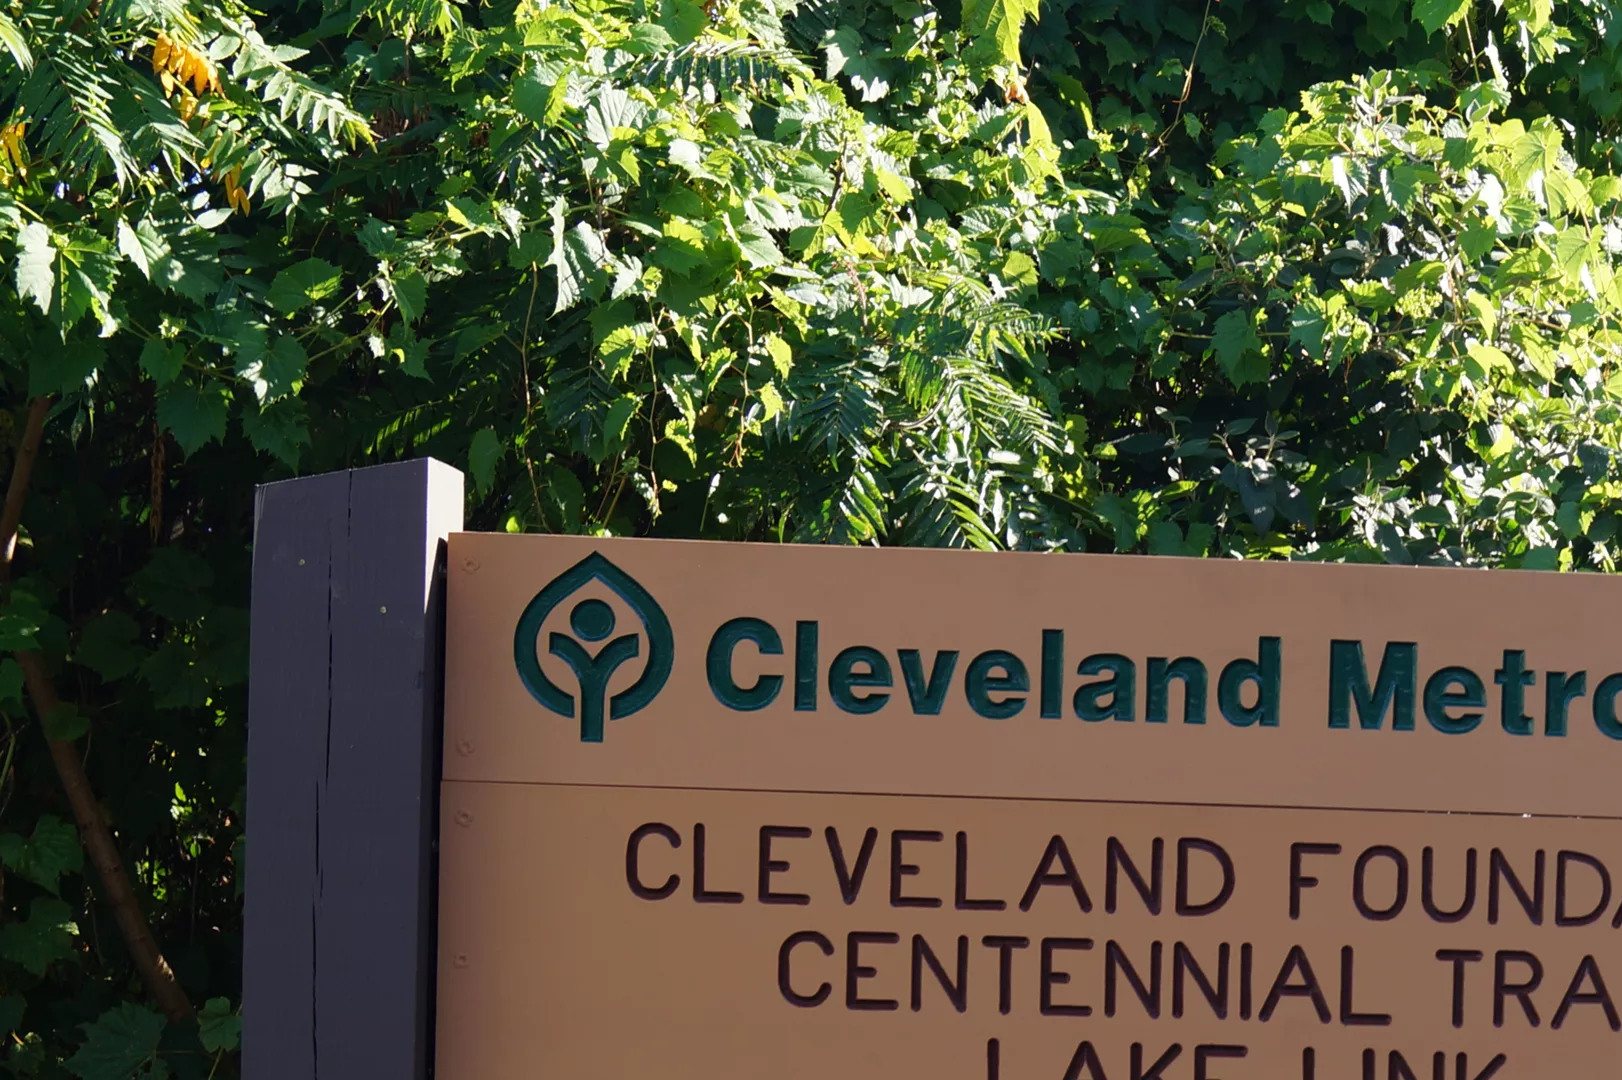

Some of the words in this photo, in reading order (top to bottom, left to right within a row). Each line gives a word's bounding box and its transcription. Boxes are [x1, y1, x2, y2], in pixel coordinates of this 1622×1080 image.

[706, 617, 1282, 727] Cleveland
[626, 823, 1235, 916] CLEVELAND
[778, 931, 1392, 1026] CENTENNIAL
